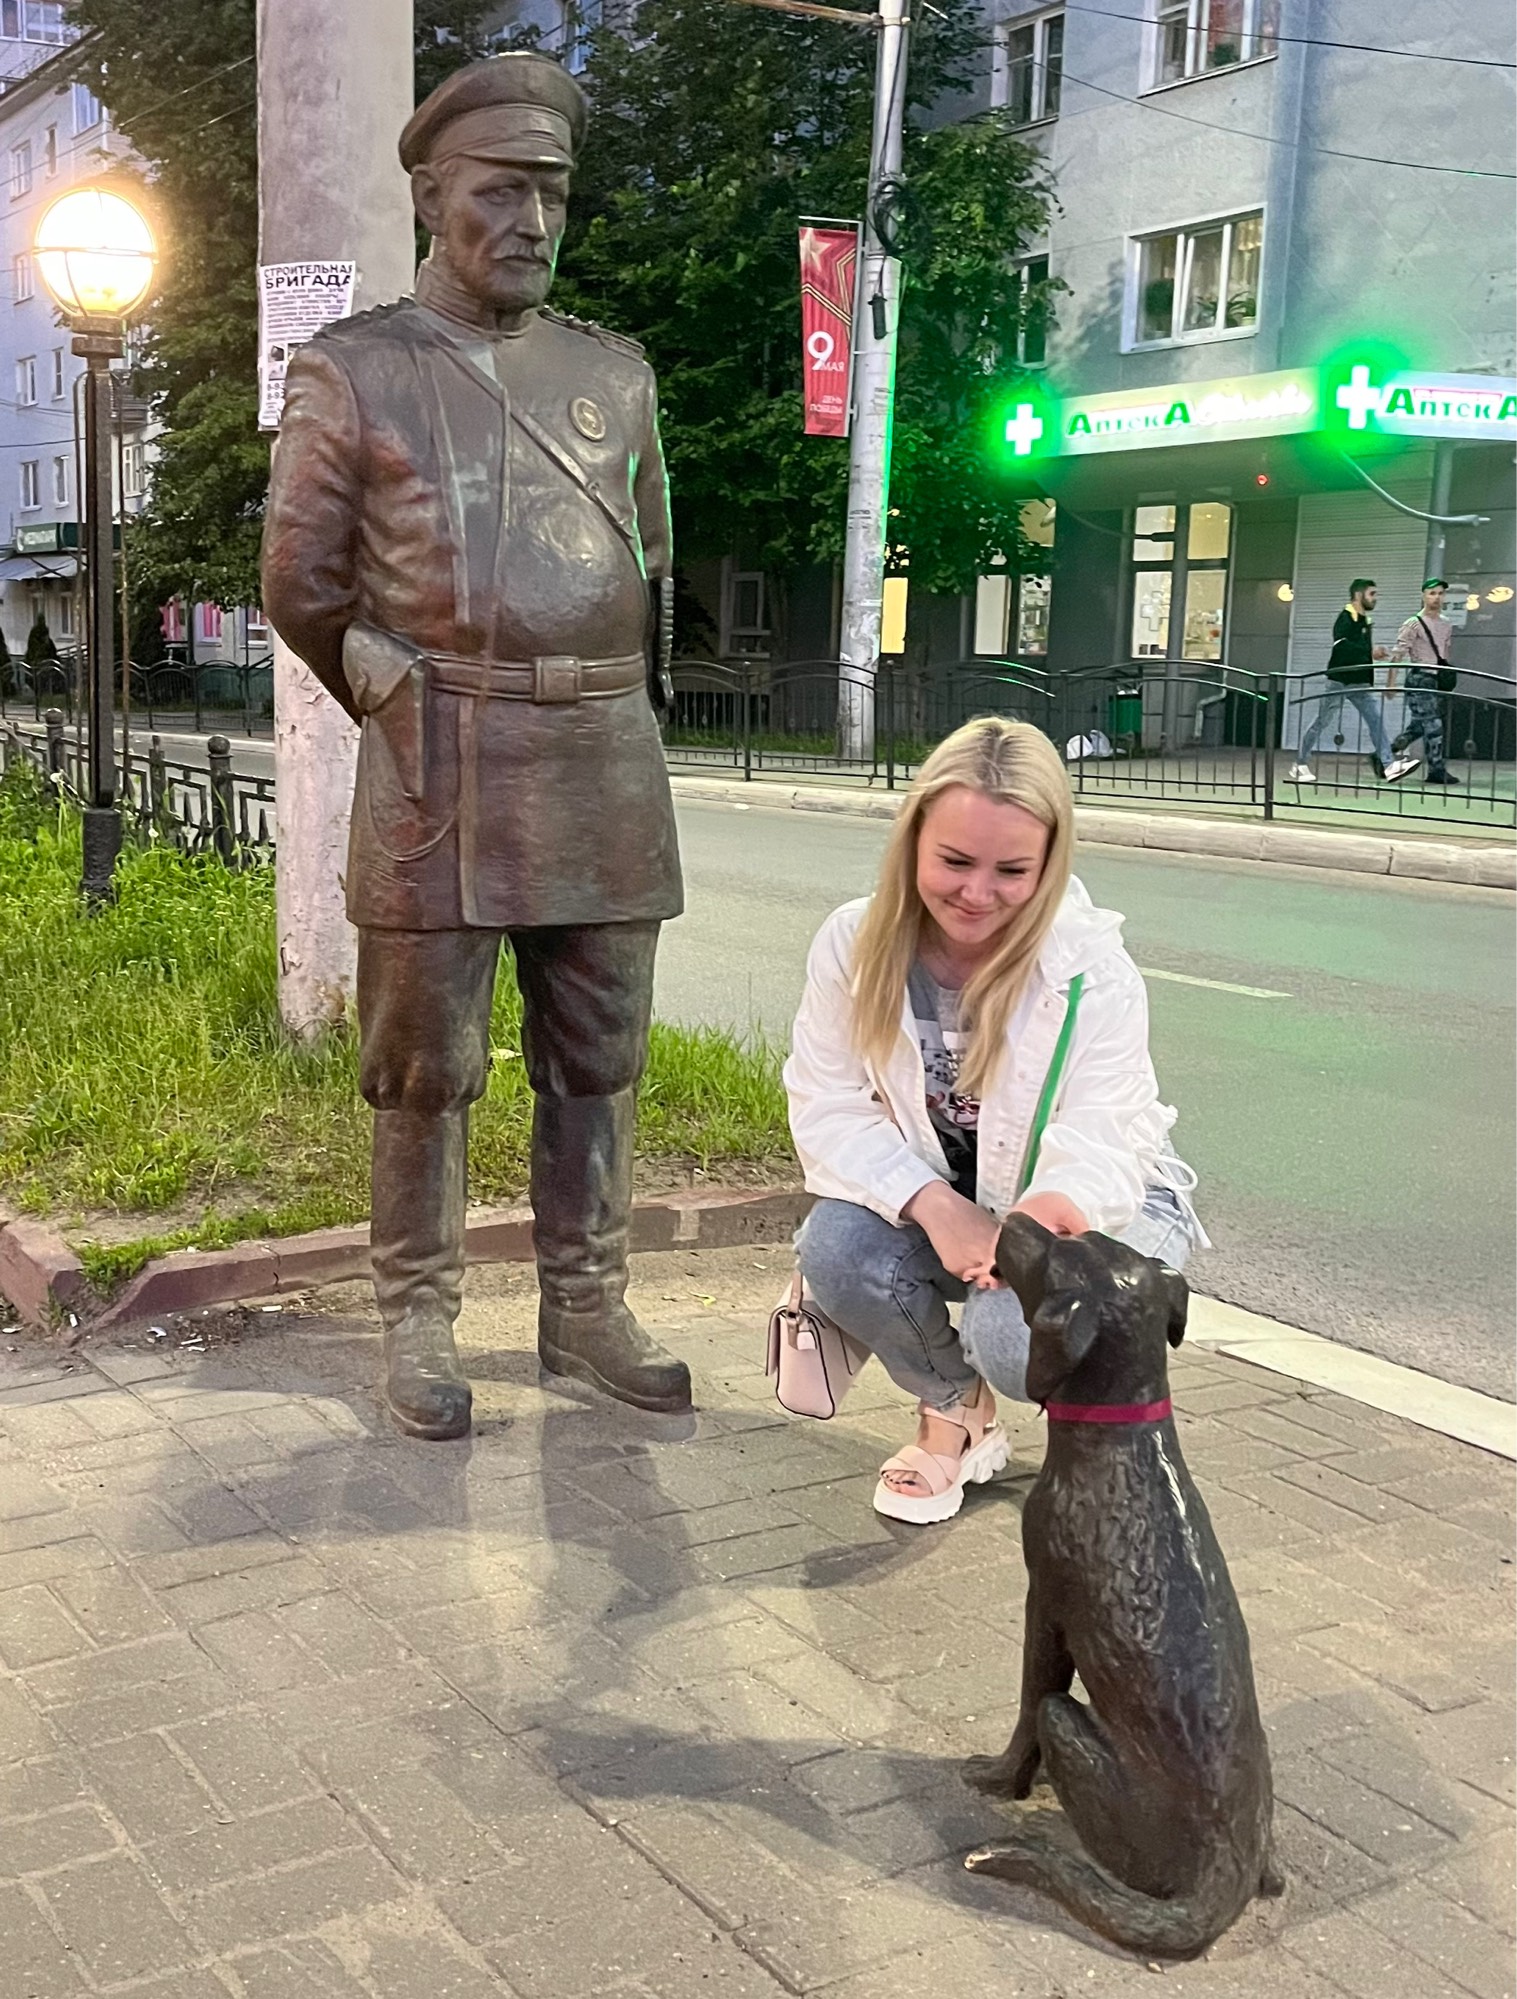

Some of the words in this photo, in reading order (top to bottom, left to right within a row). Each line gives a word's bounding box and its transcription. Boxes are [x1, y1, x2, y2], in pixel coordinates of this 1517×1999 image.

[265, 274, 351, 289] БРИГАДА
[807, 330, 834, 370] 9
[821, 361, 845, 372] МАЯ
